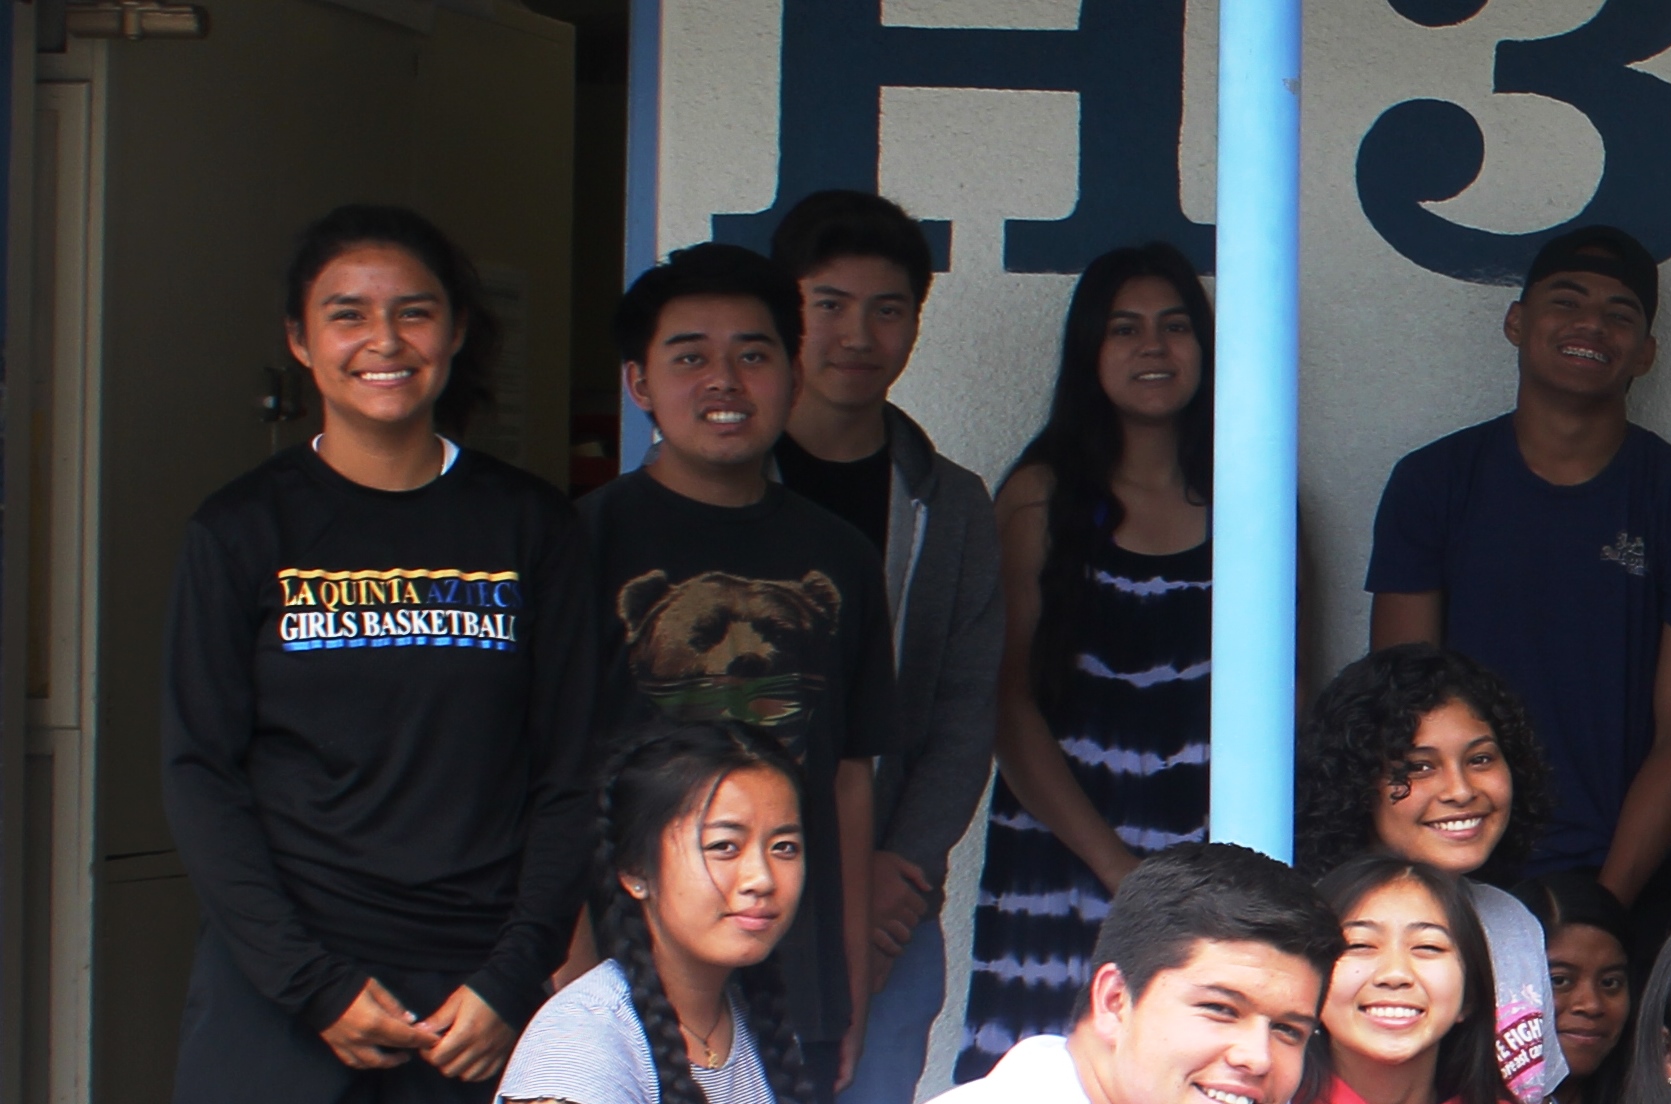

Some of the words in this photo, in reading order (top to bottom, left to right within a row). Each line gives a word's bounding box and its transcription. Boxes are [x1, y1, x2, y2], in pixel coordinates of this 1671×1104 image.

[280, 579, 317, 607] LA
[320, 579, 421, 612] QUINTA
[281, 611, 358, 641] GIRLS
[362, 609, 516, 642] BASKETBALL
[1503, 1017, 1543, 1051] FIGH
